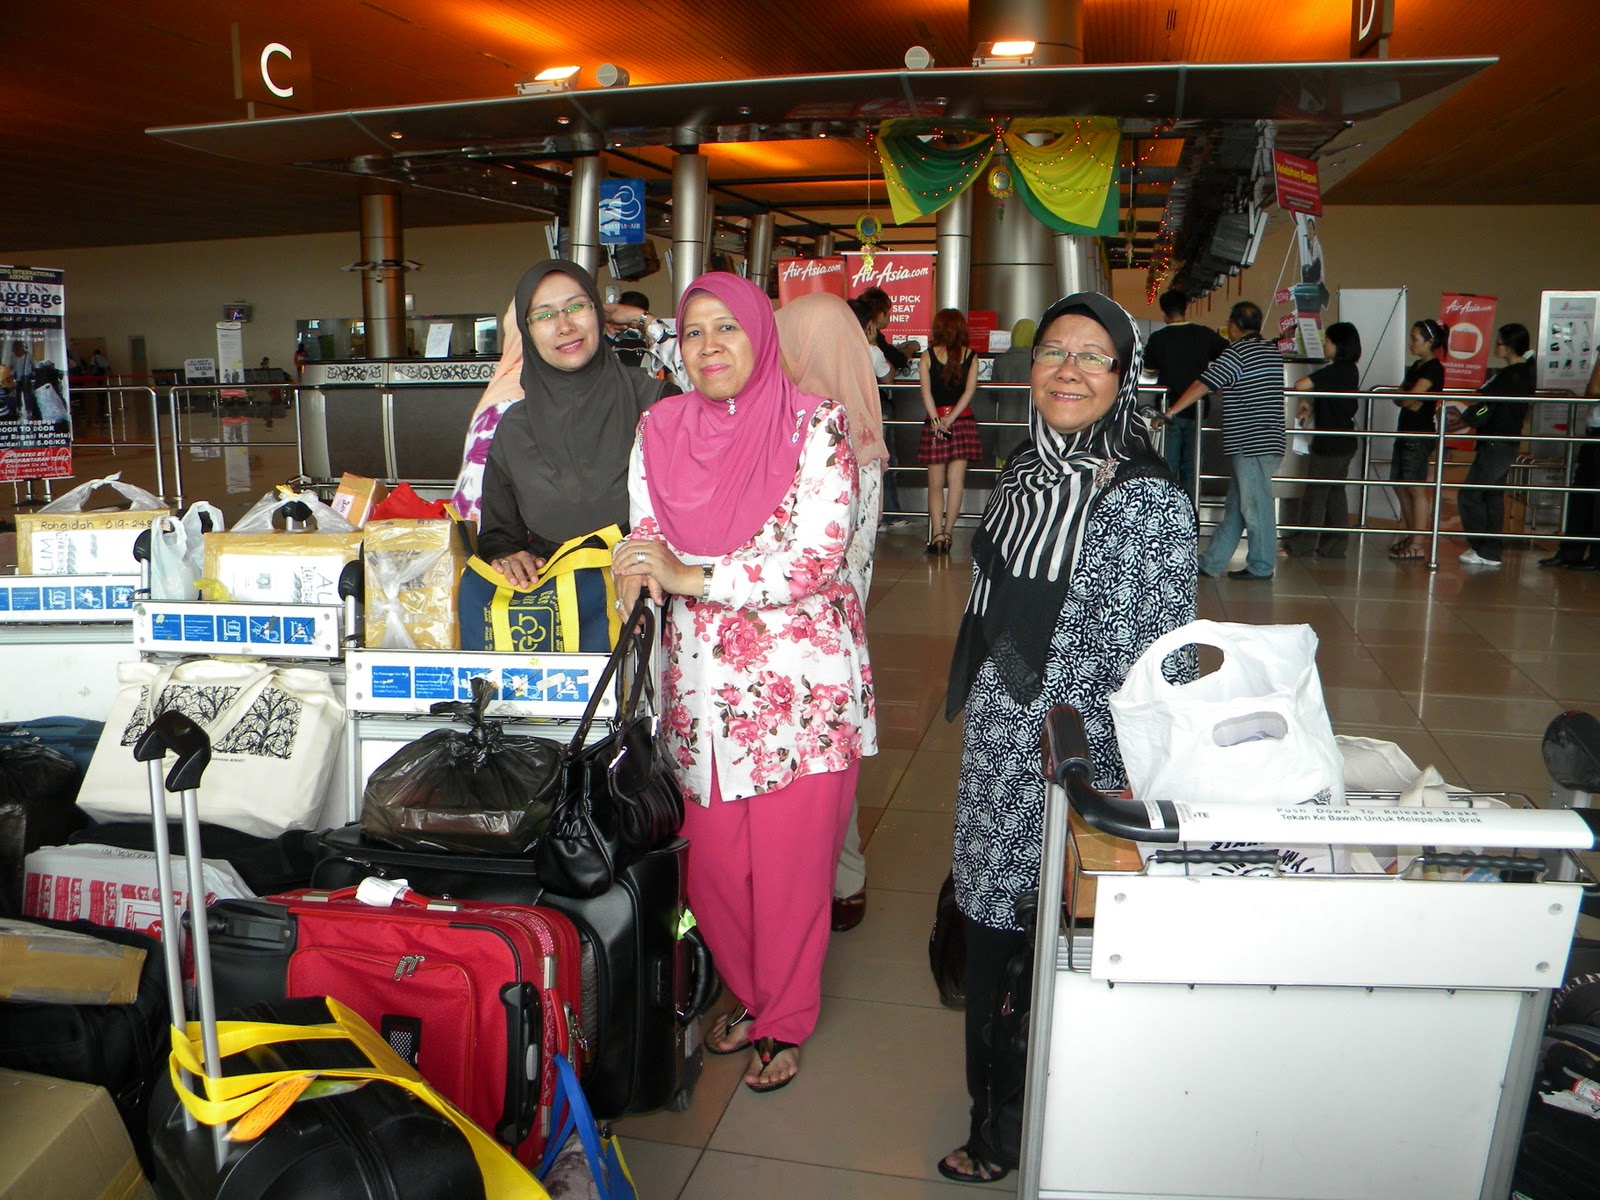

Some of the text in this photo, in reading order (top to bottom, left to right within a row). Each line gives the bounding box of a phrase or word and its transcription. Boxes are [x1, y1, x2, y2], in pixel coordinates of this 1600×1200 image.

[260, 42, 294, 98] C
[12, 269, 56, 277] INTERNATIONAL
[0, 282, 49, 293] EXCESS
[0, 291, 62, 308] aggage
[899, 295, 921, 303] PICK
[892, 304, 915, 313] SEAT
[889, 314, 910, 323] INE?
[11, 433, 37, 441] Bagasi
[1396, 816, 1458, 824] Melepaskan
